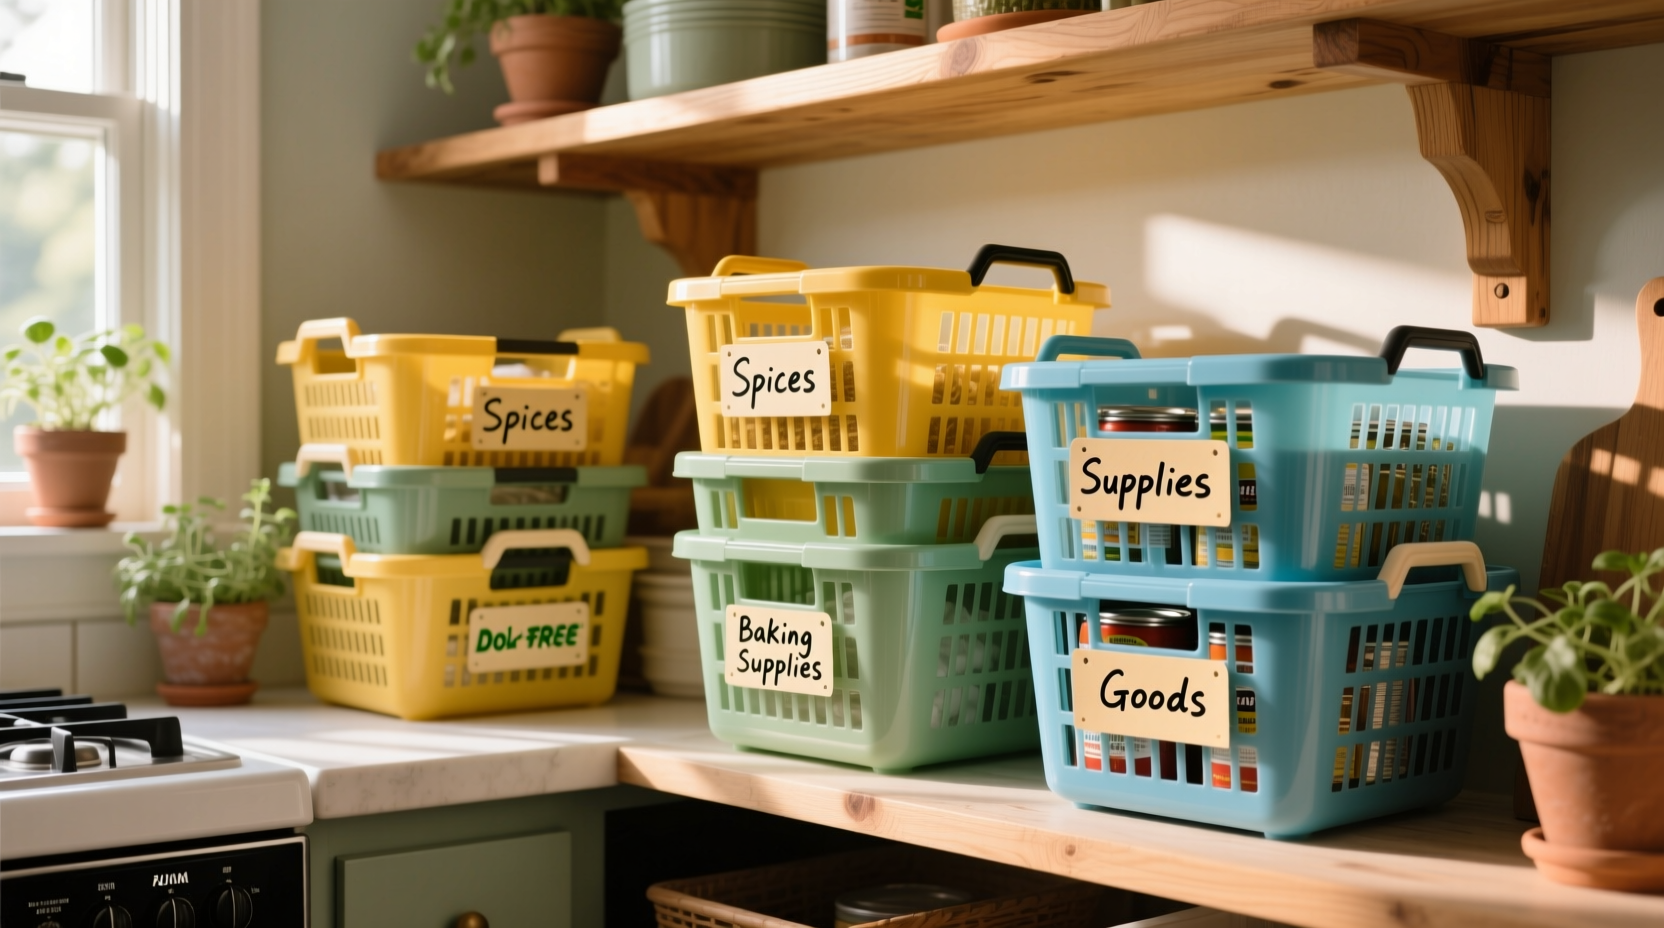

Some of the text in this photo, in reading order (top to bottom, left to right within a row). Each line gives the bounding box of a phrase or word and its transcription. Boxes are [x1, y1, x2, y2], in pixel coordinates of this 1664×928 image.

[732, 356, 817, 411] Spices
[482, 397, 574, 446] Spices
[1080, 456, 1212, 512] Supplies
[739, 615, 813, 659] Baking
[737, 648, 823, 688] Supplies
[1100, 668, 1207, 719] Goods
